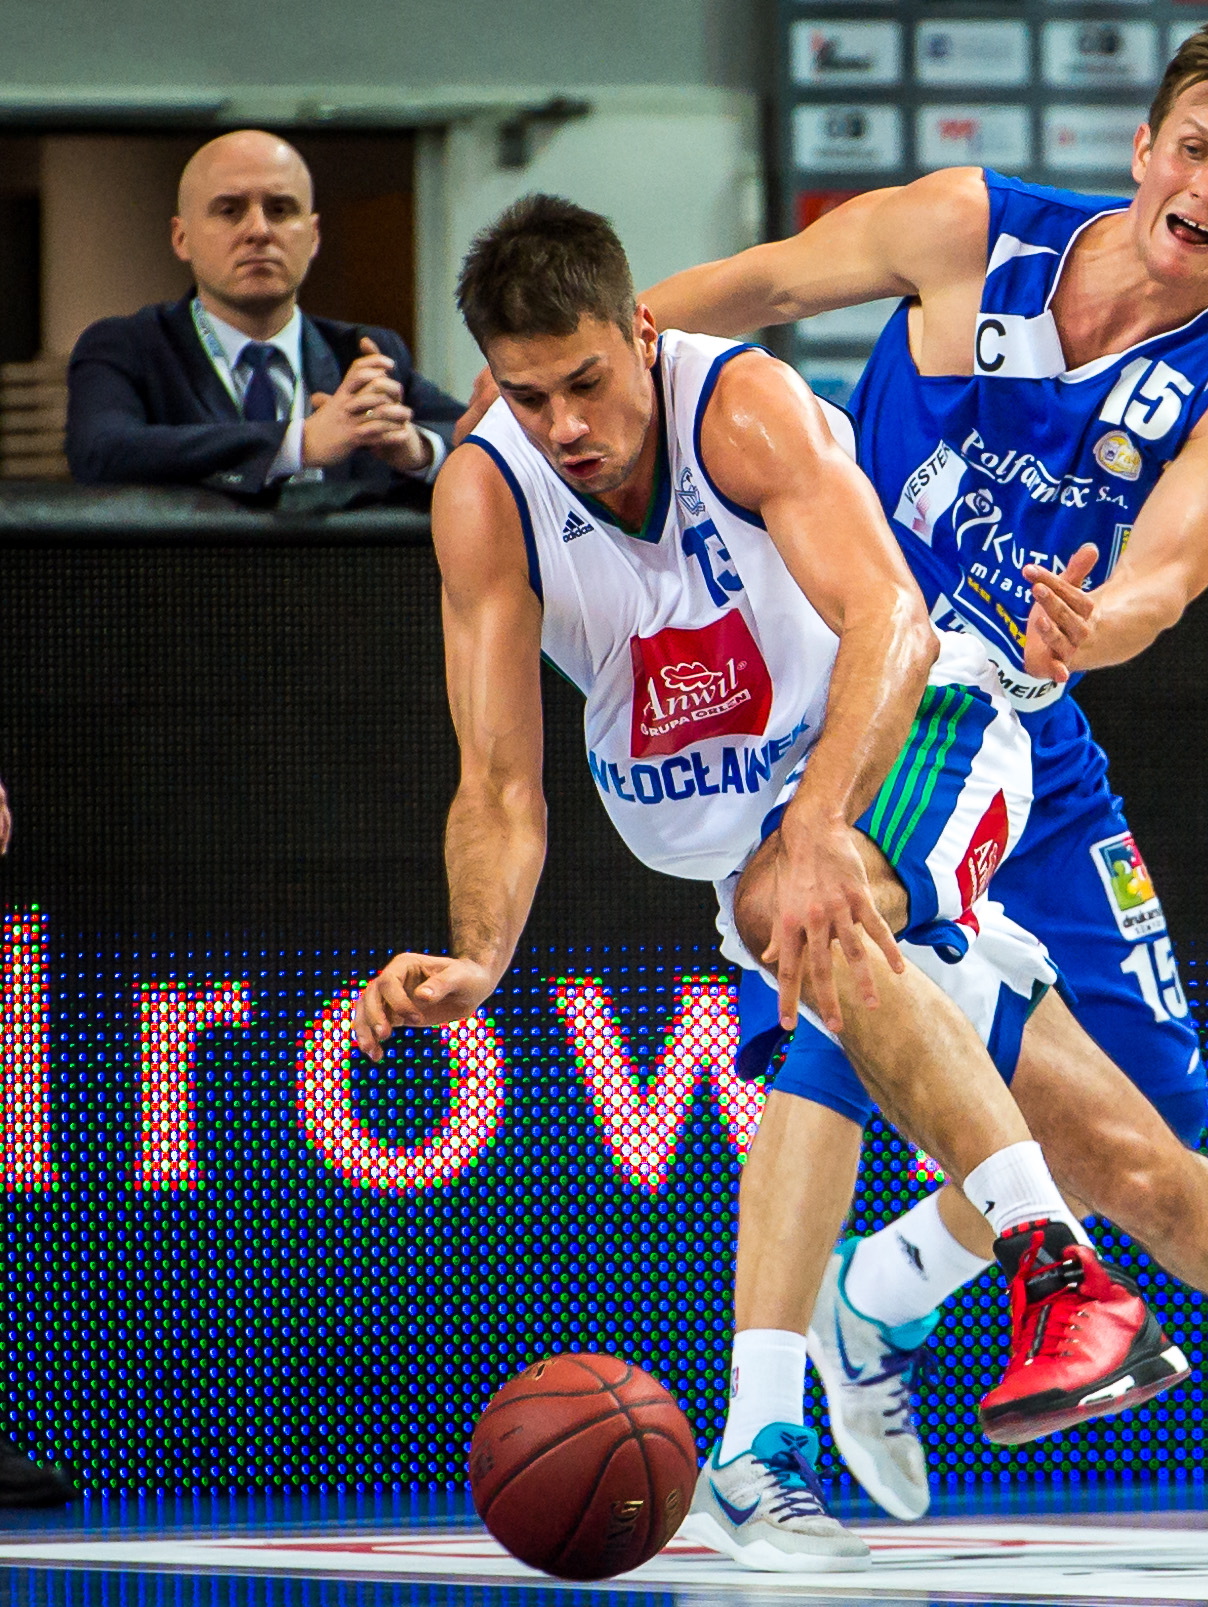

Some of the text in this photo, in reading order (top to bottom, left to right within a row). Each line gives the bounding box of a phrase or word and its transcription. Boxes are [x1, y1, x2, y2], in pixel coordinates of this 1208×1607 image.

[976, 319, 1006, 372] C
[1099, 356, 1195, 440] 15
[562, 523, 595, 543] adidas
[970, 562, 1033, 604] miast
[640, 691, 747, 737] GRUPA ORLEN
[643, 657, 739, 721] Anwil
[1120, 936, 1189, 1024] 15
